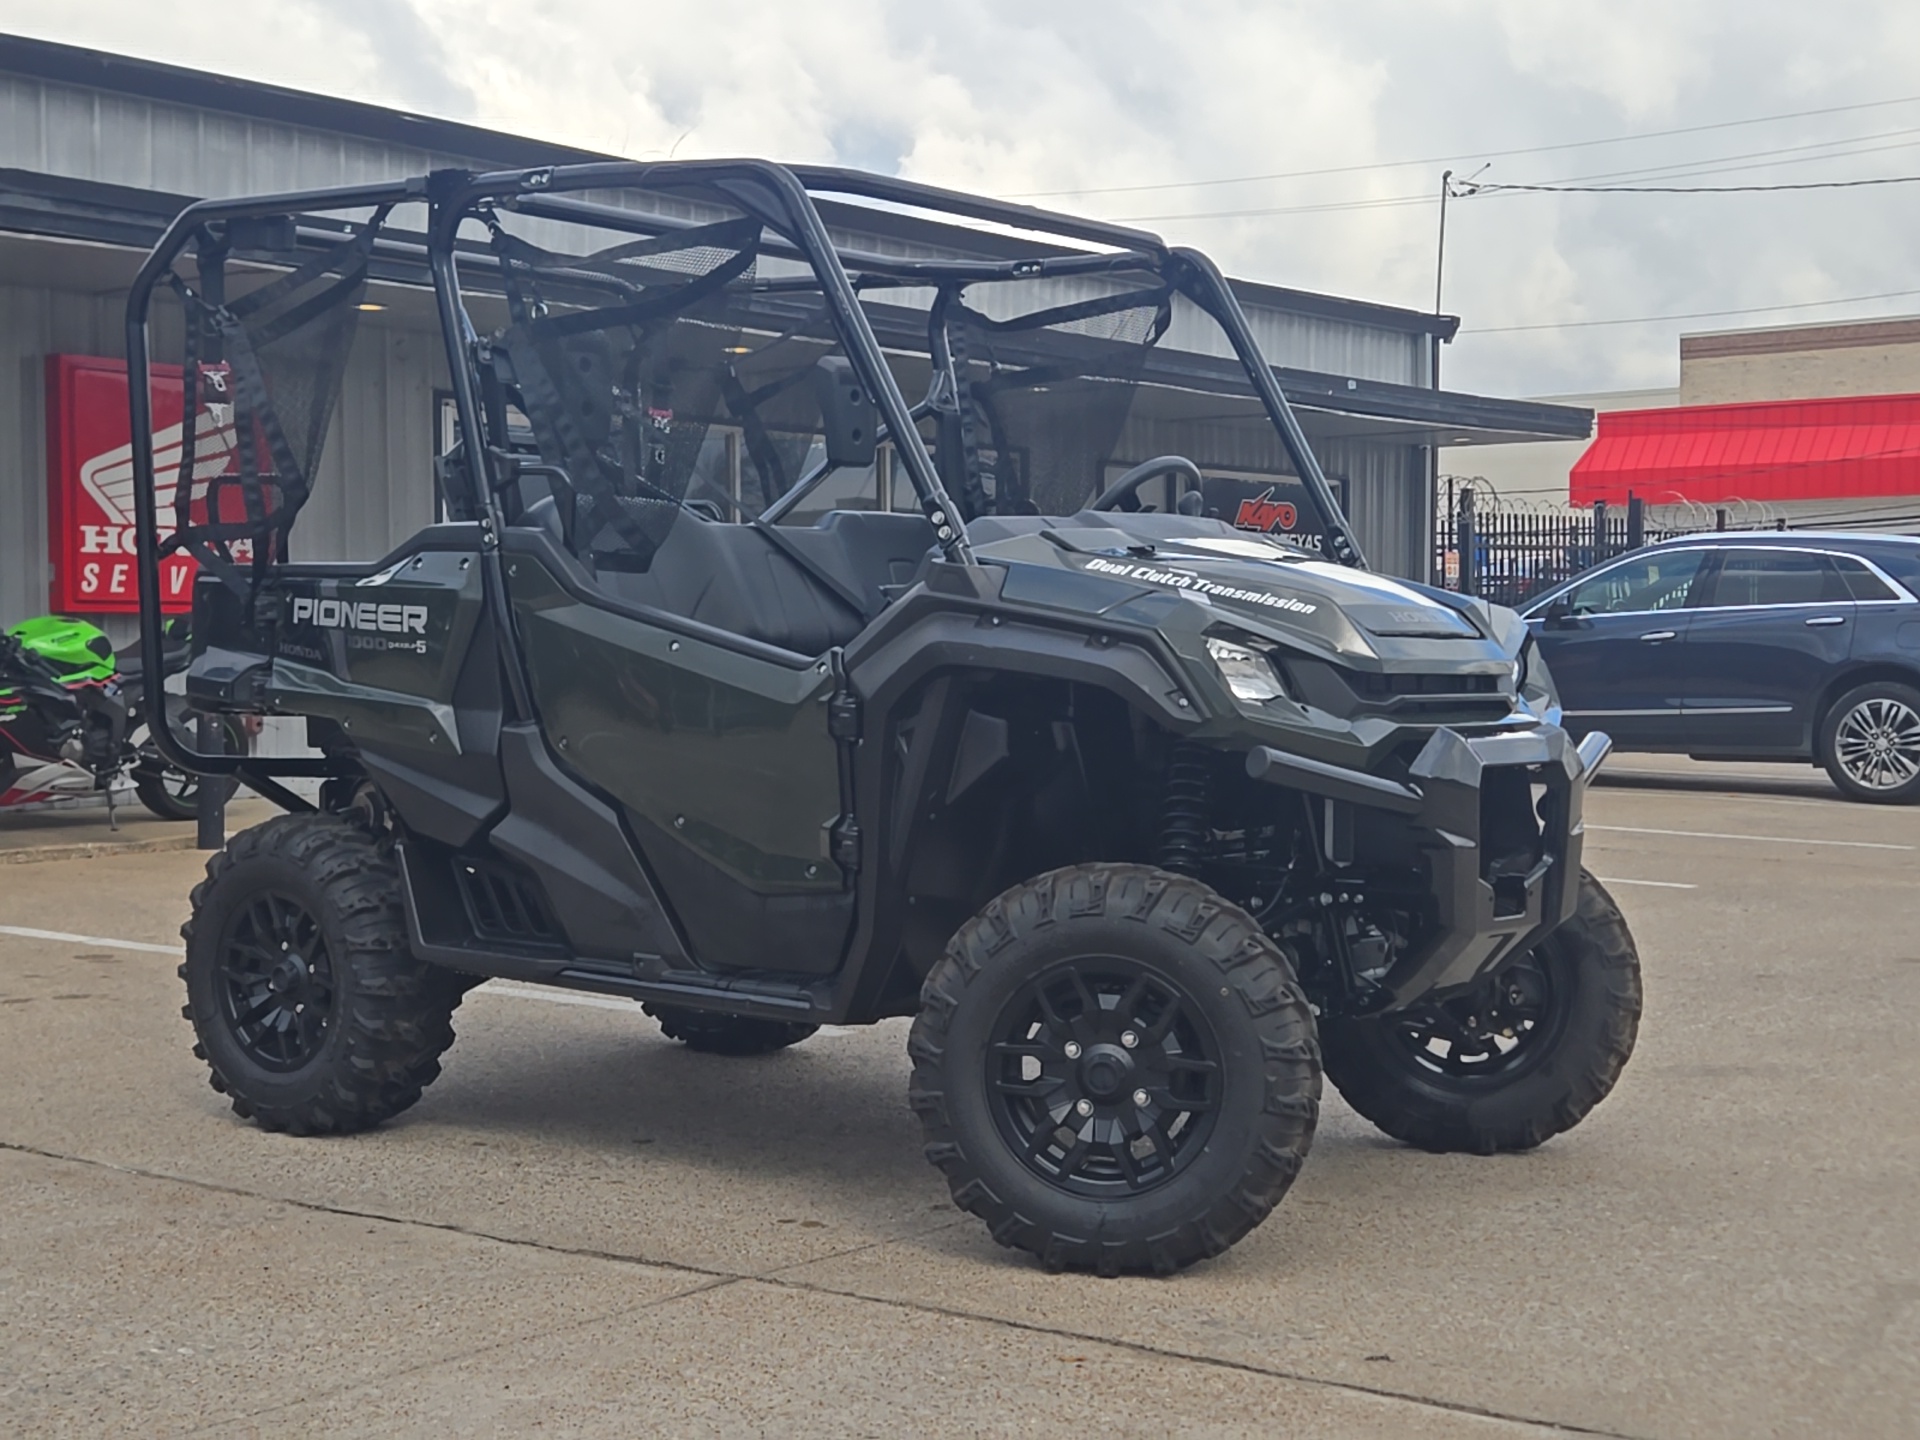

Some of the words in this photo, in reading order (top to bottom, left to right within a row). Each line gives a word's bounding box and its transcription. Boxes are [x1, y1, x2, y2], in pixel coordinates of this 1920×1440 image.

[1085, 558, 1134, 576] Dual
[1131, 567, 1192, 588] Clutch
[1193, 578, 1317, 615] Transmission
[293, 597, 428, 634] PIONEER
